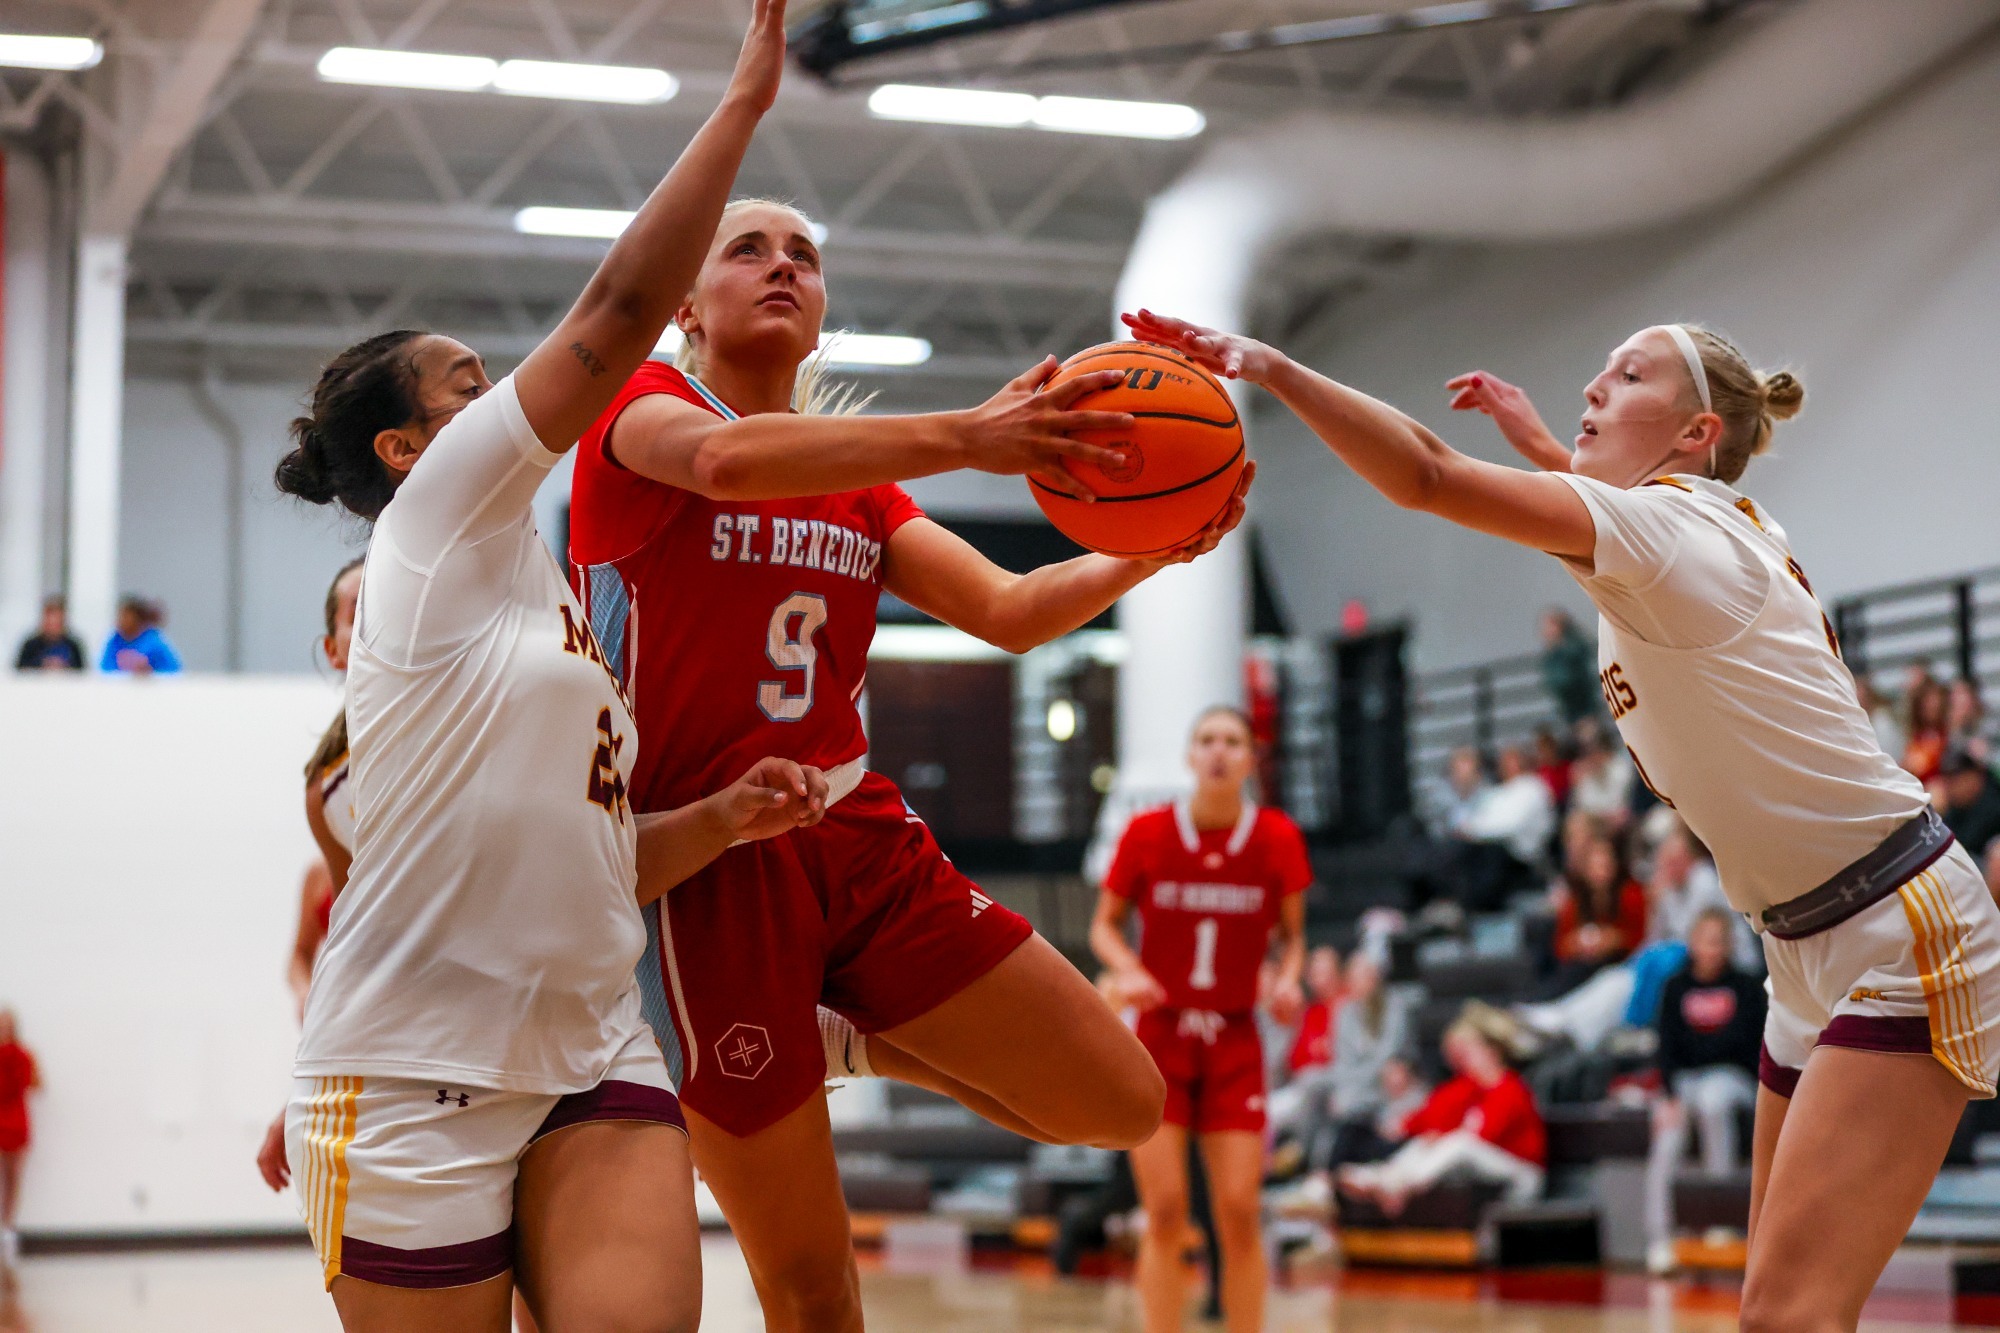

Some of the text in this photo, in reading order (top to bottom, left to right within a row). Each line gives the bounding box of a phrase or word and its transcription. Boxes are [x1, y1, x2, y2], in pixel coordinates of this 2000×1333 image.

[710, 513, 762, 563] ST.
[756, 591, 827, 723] 9
[1188, 917, 1218, 991] 1
